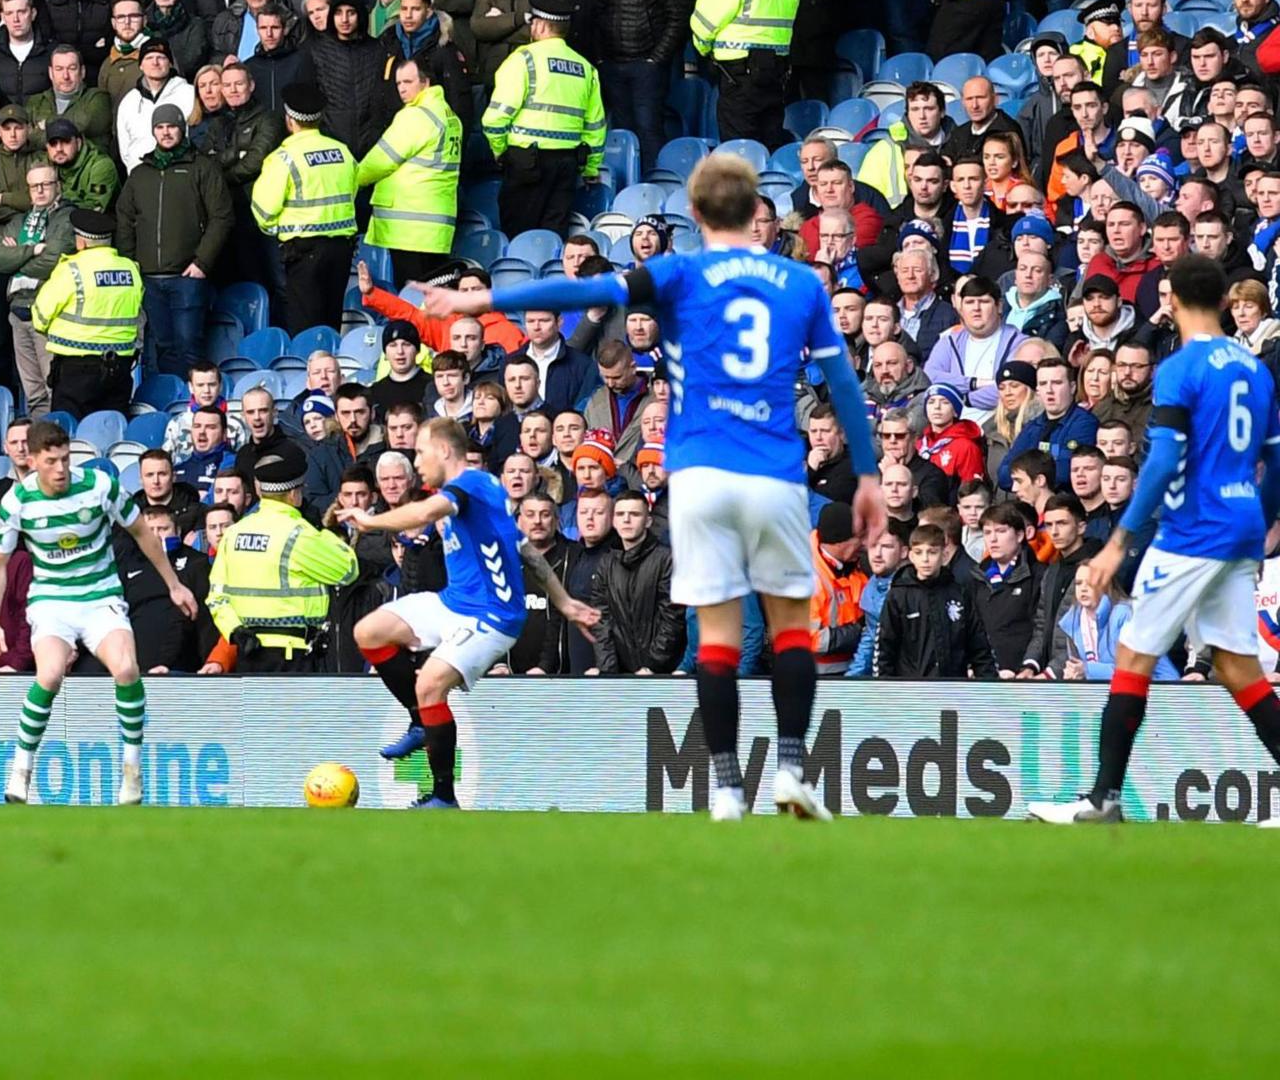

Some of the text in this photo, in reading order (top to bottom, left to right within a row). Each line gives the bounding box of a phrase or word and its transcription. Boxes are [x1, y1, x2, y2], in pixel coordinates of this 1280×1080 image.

[549, 58, 585, 77] POLICE
[305, 150, 343, 164] POLICE
[95, 272, 133, 286] POLICE
[721, 296, 771, 383] 3
[1228, 380, 1253, 453] 6
[235, 534, 269, 552] POLICE
